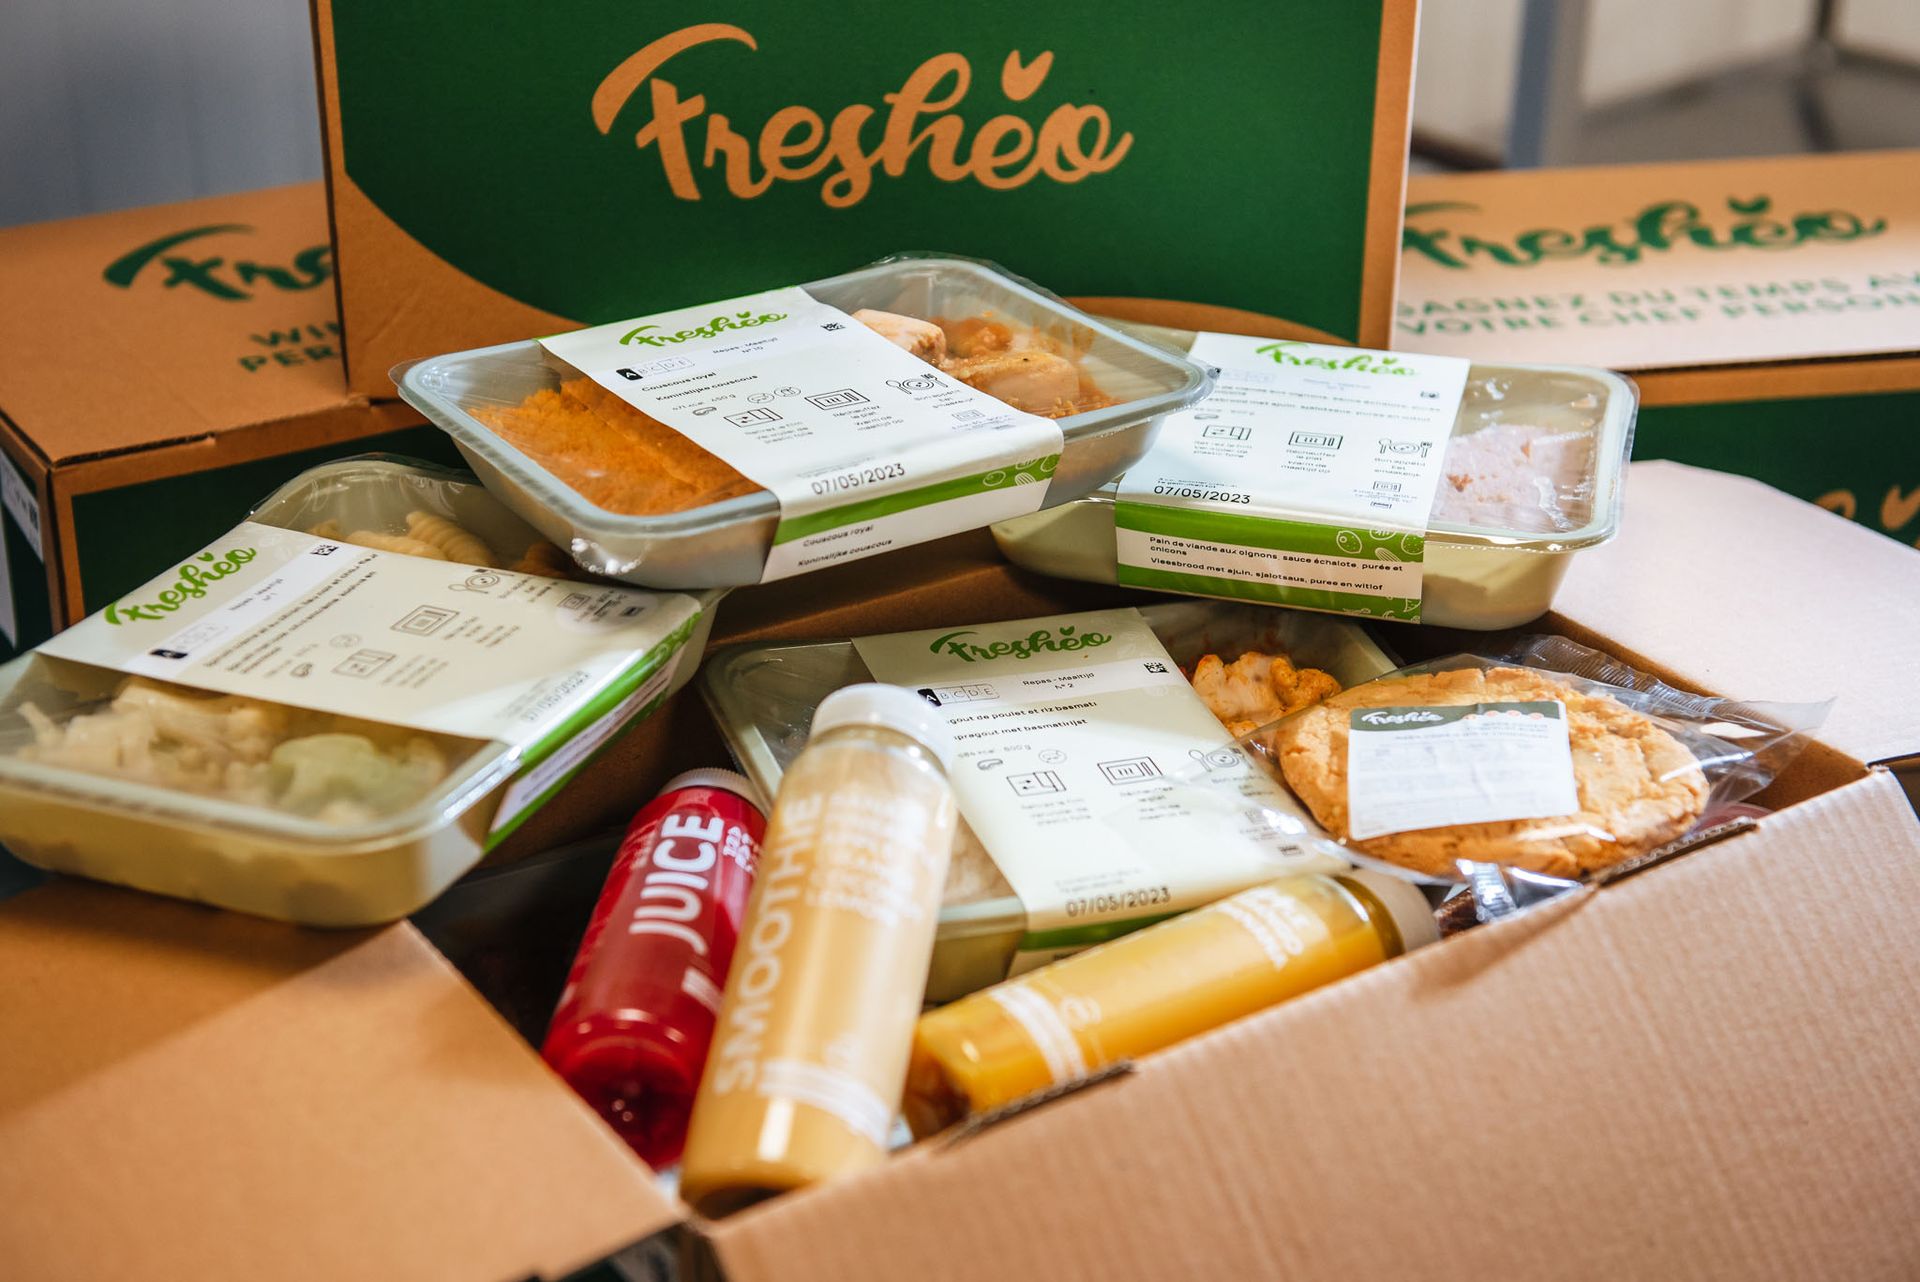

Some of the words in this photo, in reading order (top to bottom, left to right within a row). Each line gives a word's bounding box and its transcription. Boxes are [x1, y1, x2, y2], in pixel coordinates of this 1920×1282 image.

[641, 377, 691, 392] Couscous
[692, 371, 716, 383] royal
[655, 386, 711, 402] Koninklijke
[712, 374, 758, 389] couscous
[811, 463, 905, 495] 07/05/2023
[1154, 484, 1251, 504] 07/05/2023
[803, 532, 849, 547] Couscous
[850, 525, 874, 537] royal
[798, 550, 848, 567] Koninklijke
[849, 540, 892, 555] couscous
[1149, 536, 1171, 545] Pain
[1186, 543, 1218, 552] viande
[1282, 555, 1312, 564] sauce
[1361, 562, 1391, 571] purée
[1150, 557, 1205, 570] Vleesbrood
[1206, 564, 1225, 573] met
[1227, 568, 1254, 577] ajuin,
[1310, 577, 1339, 587] puree
[1354, 582, 1384, 591] witlof
[1022, 677, 1053, 687] Repas
[1058, 671, 1095, 683] Maaltijd
[947, 709, 976, 725] gout
[976, 713, 990, 721] de
[992, 709, 1026, 721] poulet
[1040, 706, 1054, 714] riz
[1055, 700, 1098, 713] basmati
[1001, 726, 1023, 736] met
[628, 814, 725, 956] JUICE
[1066, 885, 1171, 917] 07/05/2023
[715, 793, 824, 1095] SMOOTHIE
